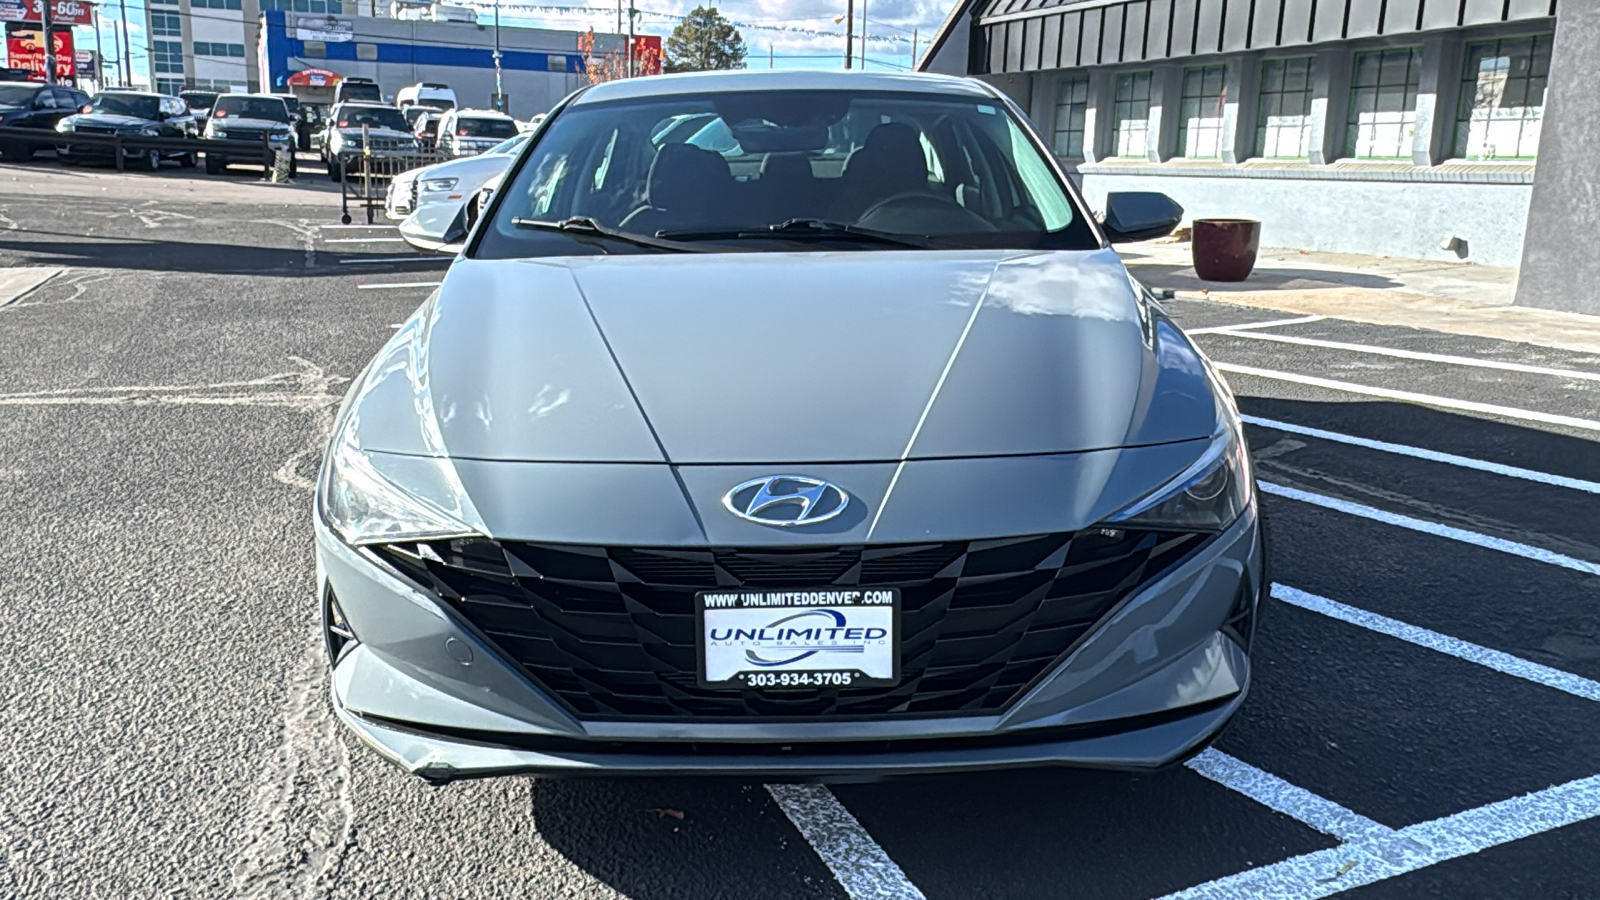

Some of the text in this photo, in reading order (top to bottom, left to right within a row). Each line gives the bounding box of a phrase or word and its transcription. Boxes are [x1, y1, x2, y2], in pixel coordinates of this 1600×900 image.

[56, 54, 72, 63] Day
[10, 59, 72, 76] Delivry
[302, 67, 334, 77] ENTRANCE
[703, 591, 893, 608] WWWUNLIMITEDDENVE.COM
[710, 627, 888, 641] UNLIMITED
[747, 672, 852, 686] 303-934-3705
